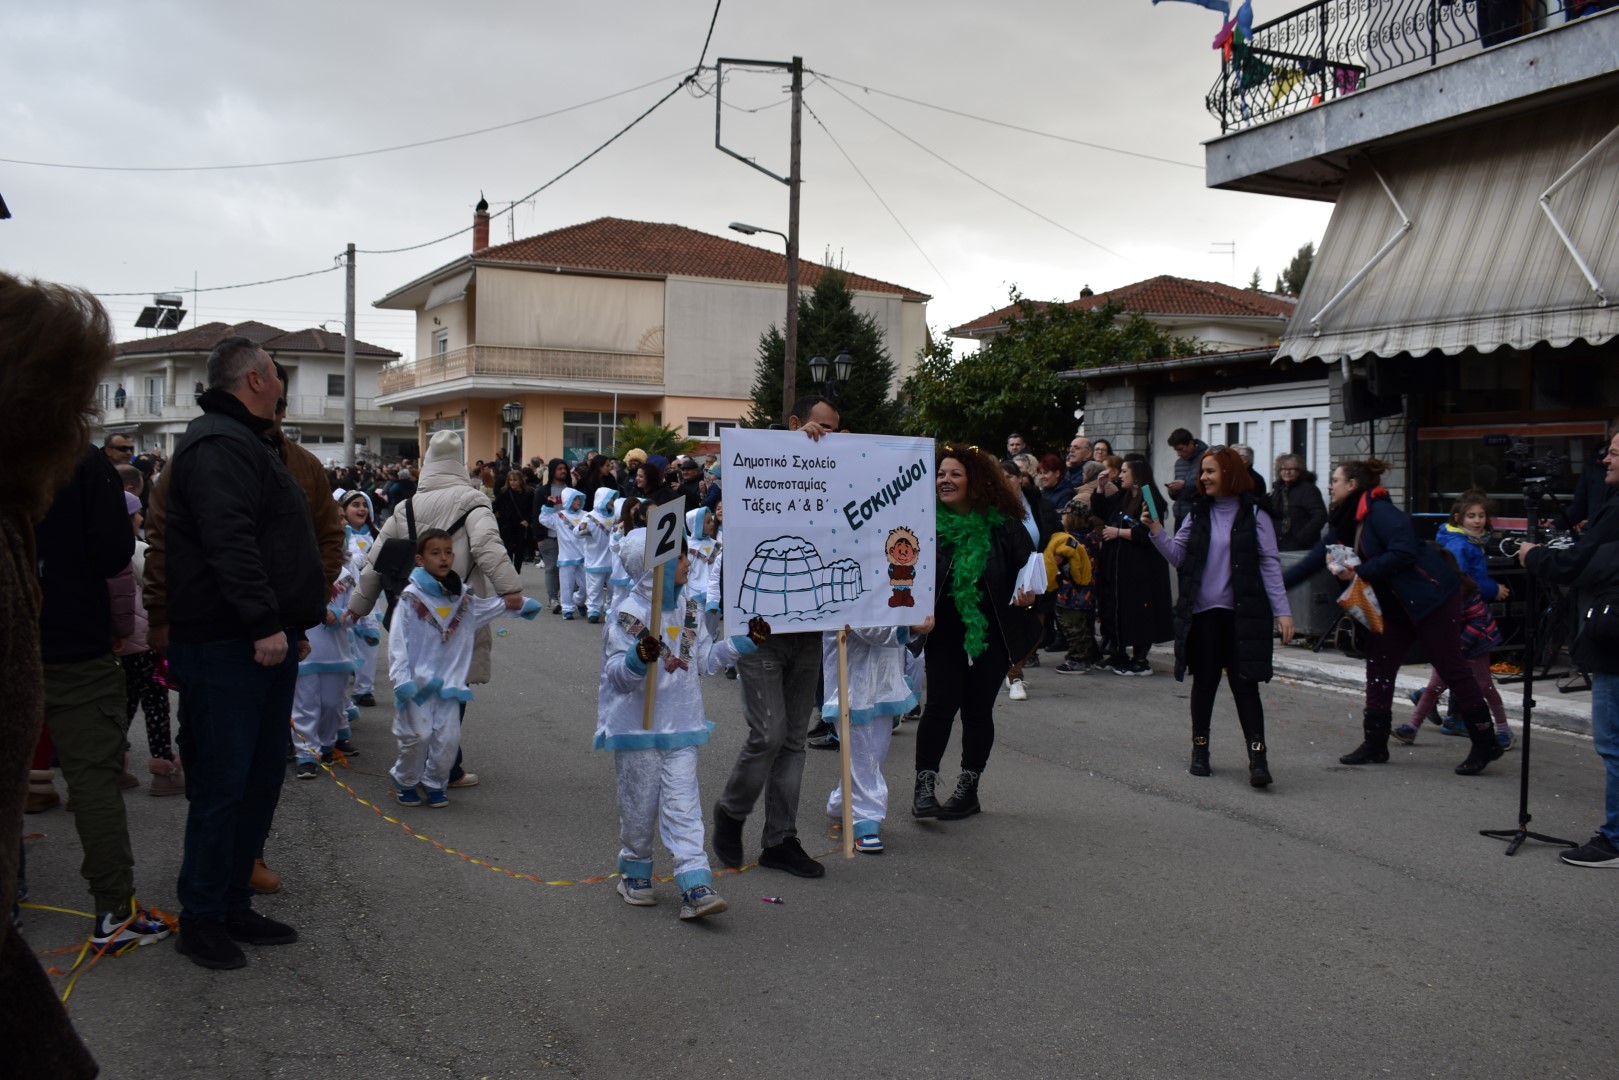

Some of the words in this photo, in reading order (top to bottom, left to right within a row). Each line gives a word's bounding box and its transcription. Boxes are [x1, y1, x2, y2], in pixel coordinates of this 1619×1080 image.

[733, 452, 787, 469] Δημοτικό
[792, 454, 836, 470] Σχολείο
[745, 475, 827, 492] Μεσοποταμίας
[842, 458, 927, 531] Εσκιμώοι
[742, 498, 782, 514] Τάξεις
[655, 512, 677, 558] 2
